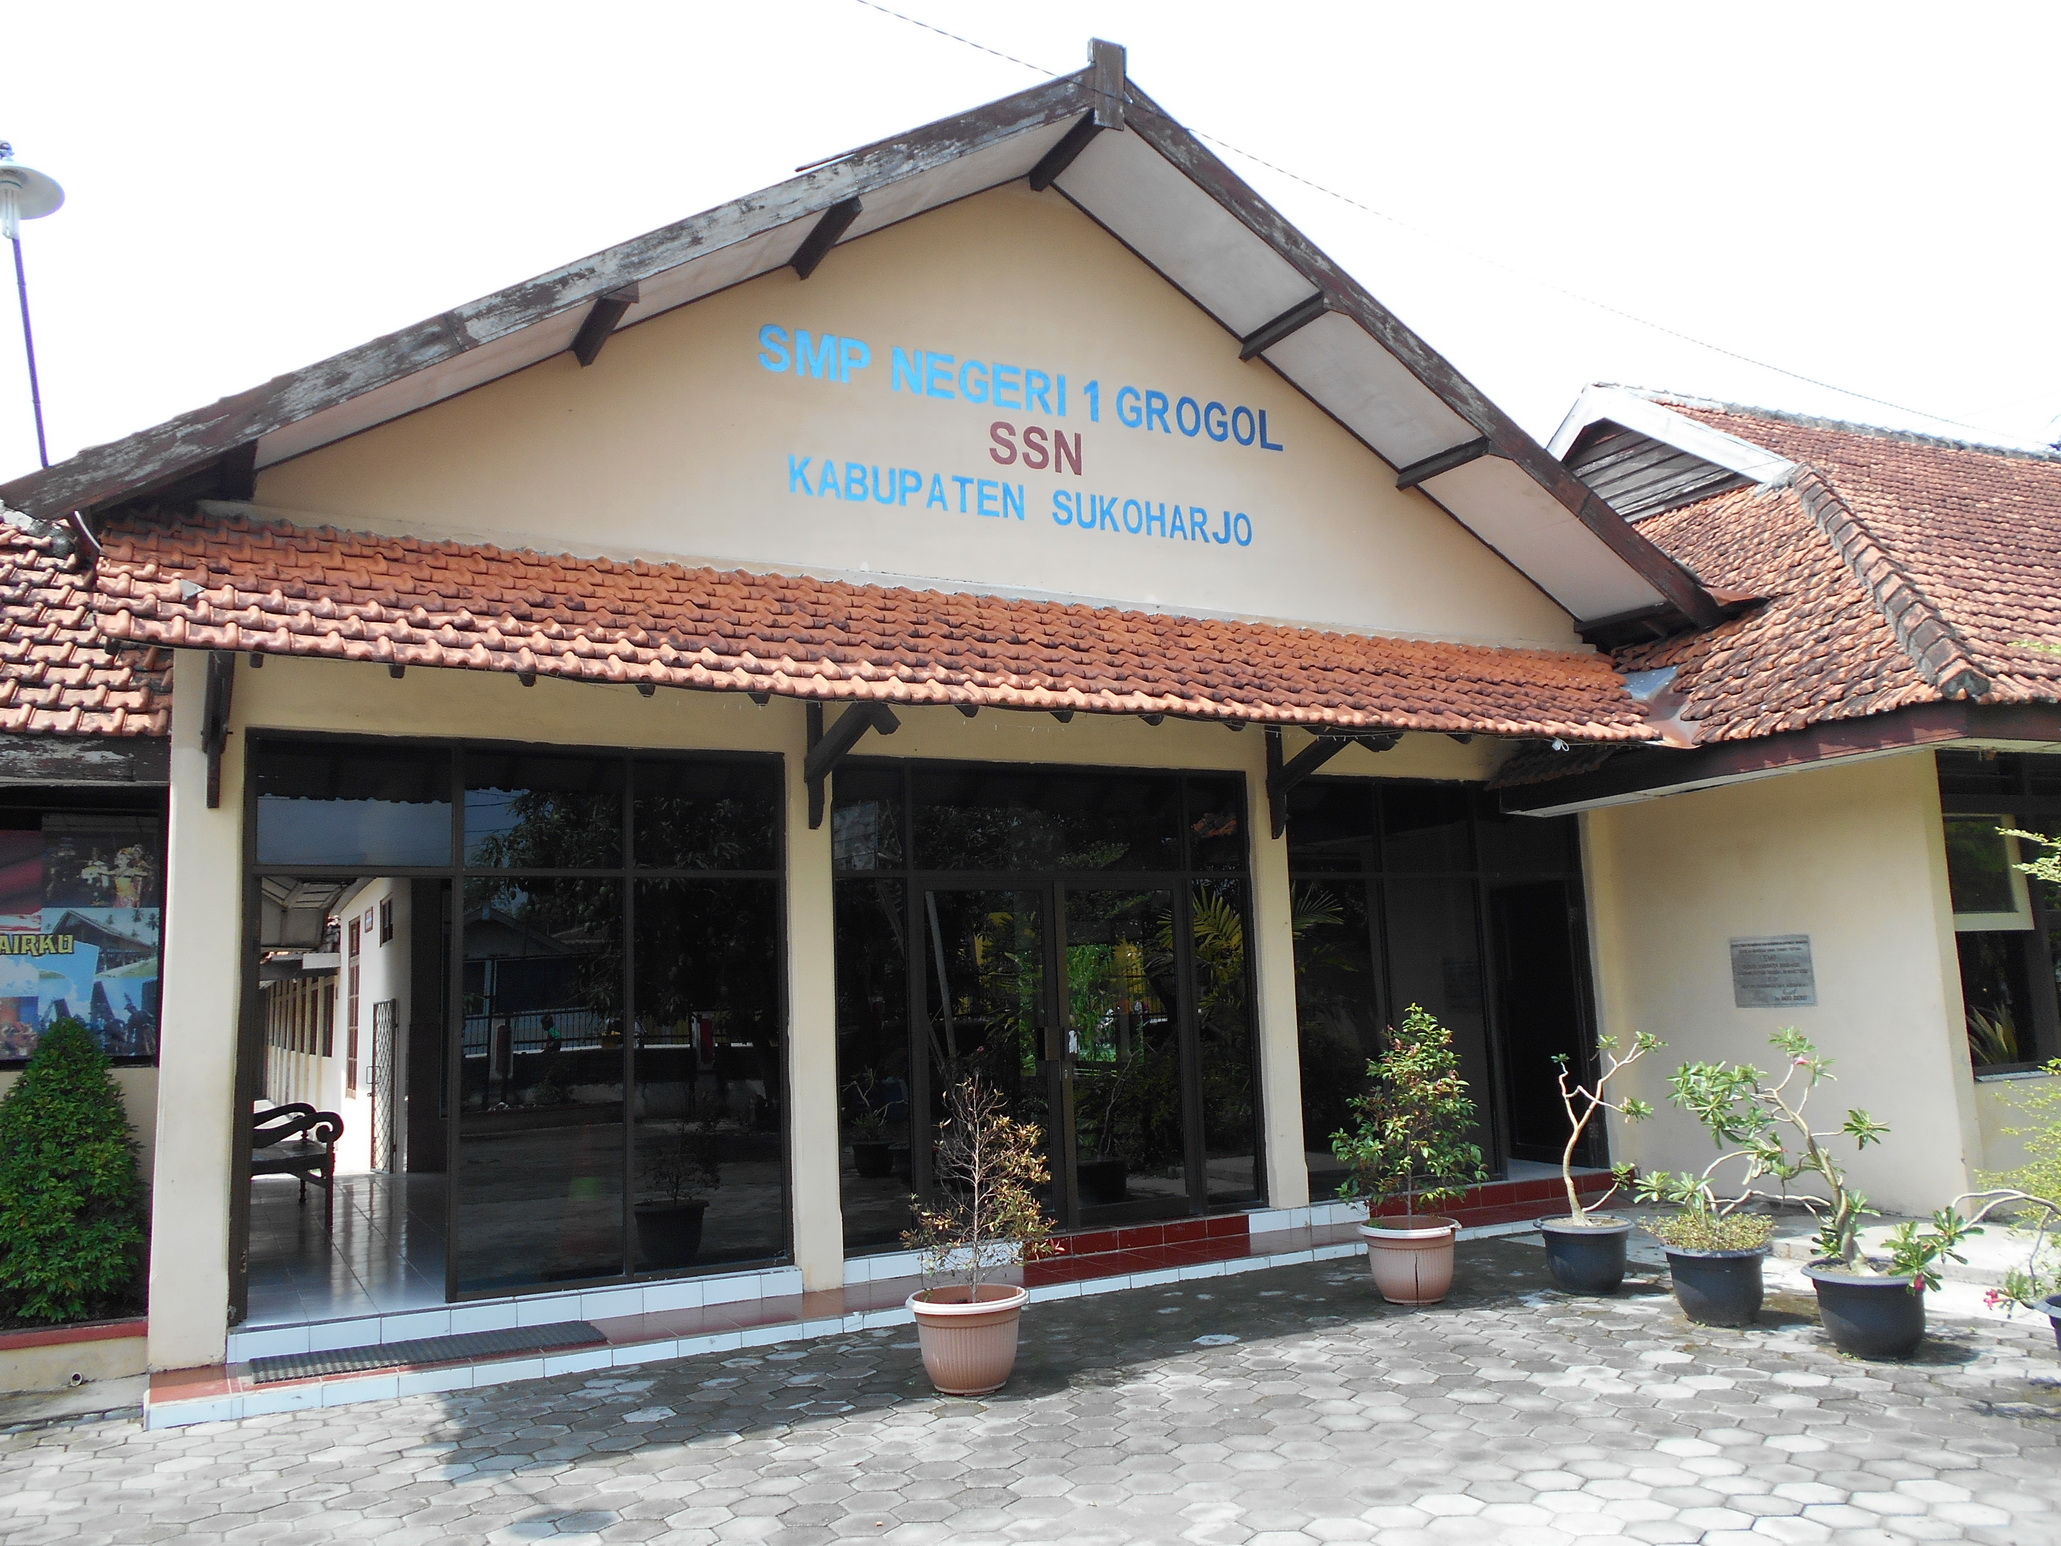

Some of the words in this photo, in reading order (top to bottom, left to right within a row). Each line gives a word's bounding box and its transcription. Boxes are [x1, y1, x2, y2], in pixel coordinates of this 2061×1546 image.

[758, 324, 872, 384] SMP
[891, 345, 1067, 417] NEGERI
[1083, 379, 1101, 423] 1
[1115, 385, 1284, 452] GROGOL
[989, 421, 1083, 476] SSN
[787, 454, 1026, 521] KABUPATEN
[1051, 488, 1254, 547] SUKOHARJO
